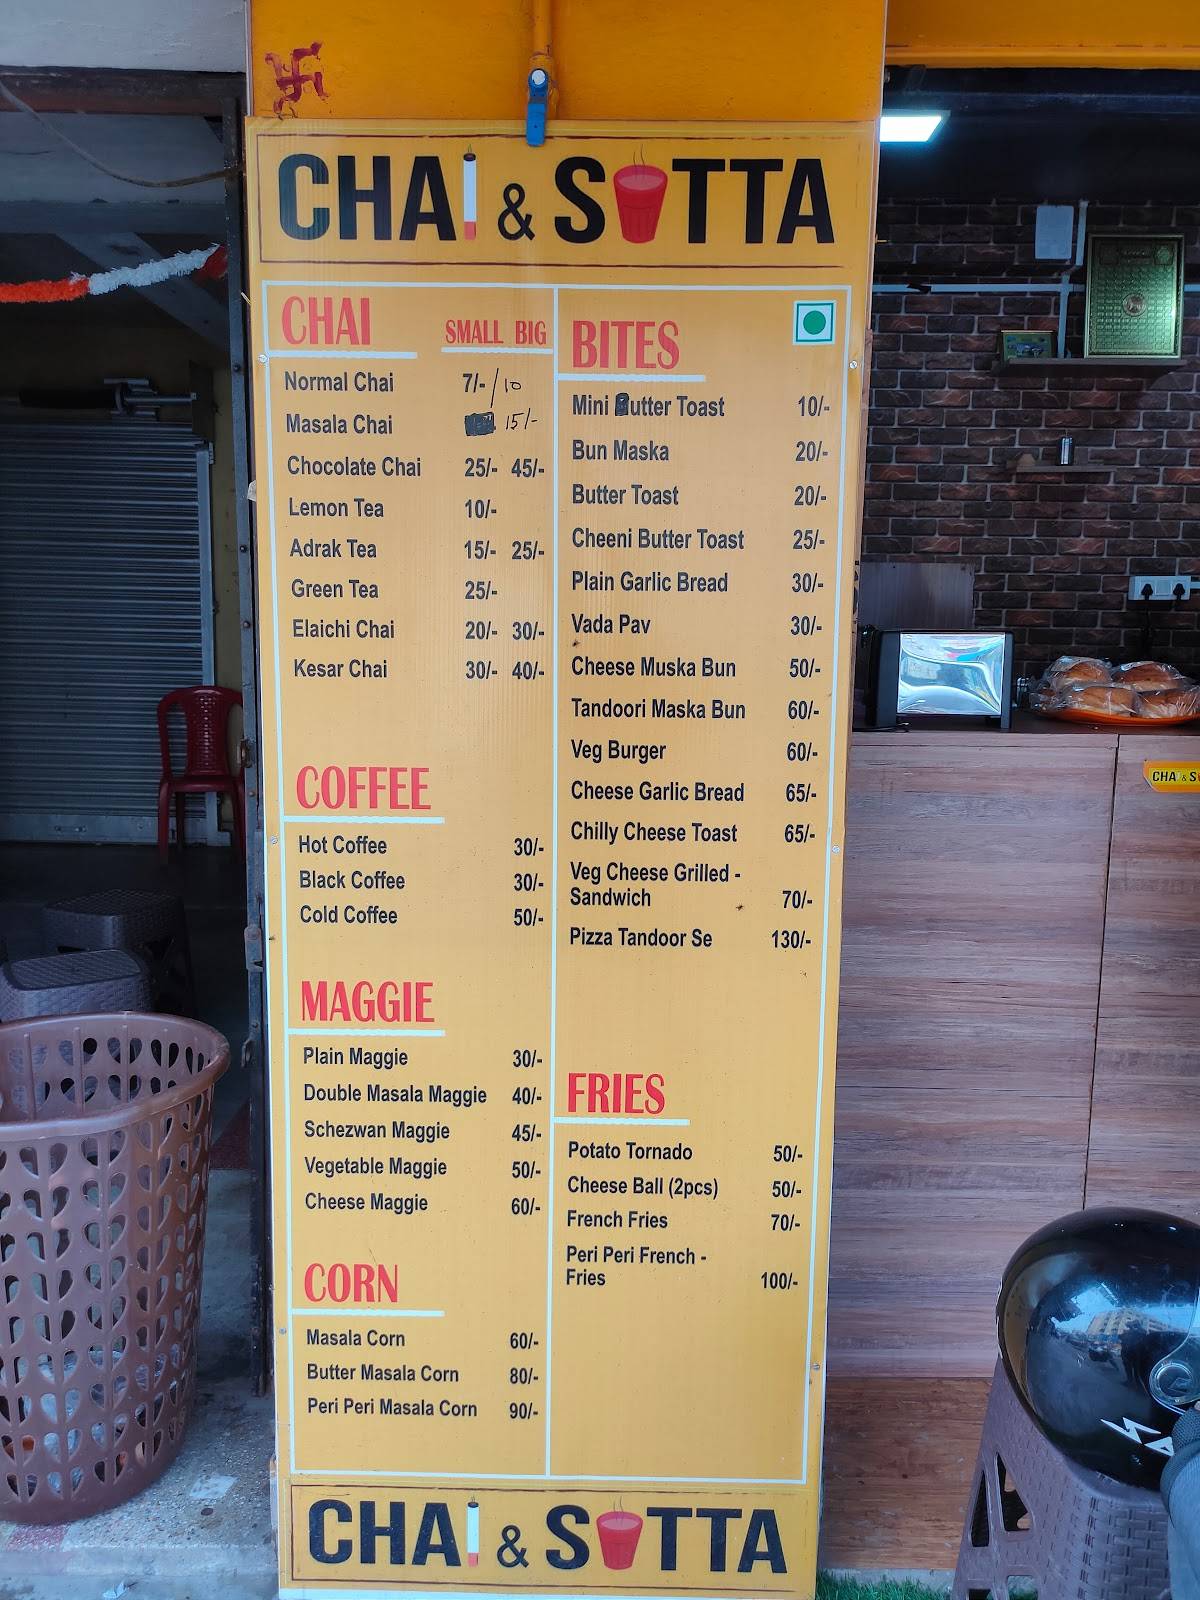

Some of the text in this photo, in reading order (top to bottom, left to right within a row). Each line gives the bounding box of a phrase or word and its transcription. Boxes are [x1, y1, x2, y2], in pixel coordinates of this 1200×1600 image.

[497, 182, 536, 241] &
[281, 296, 547, 346] CHAI SMALL BIG
[572, 319, 680, 370] BITES
[284, 371, 487, 394] Normal Chai 7/-
[572, 392, 830, 417] Mini utter Toast 10/-
[286, 413, 393, 435] Masala Chai
[505, 407, 538, 430] 15/-
[572, 439, 829, 462] Bun Maska 20/-
[287, 455, 545, 478] Chocolate Chai 25/- 45/-
[572, 483, 827, 507] Butter Toast 20/-
[289, 497, 497, 519] Lemon Tea 10/-
[289, 538, 545, 561] Adrak Tea 15/- 25/-
[572, 527, 825, 550] Cheeni Butter Toast 25/-
[291, 578, 498, 600] Green Tea 25/-
[572, 570, 824, 593] Plain Garlic Bread 30/-
[292, 618, 545, 641] Elaichi Chai 20/- 30/-
[570, 613, 823, 636] Vada Pav 30/-
[294, 658, 545, 681] Kesar Chai 30/- 40/-
[571, 655, 821, 679] Cheese Muska Bun 50/-
[571, 697, 820, 720] Tandoori Maska Bun 60/-
[570, 738, 819, 765] Veg Burger 60/-
[295, 764, 432, 811] COFFEE
[571, 779, 817, 803] Cheese Garlic Bread 65/-
[570, 820, 816, 846] Chilly Cheese Toast 65/-
[298, 834, 545, 857] Hot Coffee 30/-
[299, 869, 544, 892] Black Coffee 30/-
[569, 861, 601, 886] Veg
[606, 861, 669, 882] Cheese
[673, 862, 730, 883] Grilled
[569, 886, 813, 910] Sandwich 70/-
[300, 904, 544, 927] Cold Coffee 50/-
[570, 926, 812, 949] Pizza Tandoor Se 130/-
[300, 980, 436, 1024] MAGGIE
[303, 1046, 543, 1070] Plain Maggie 30/-
[304, 1083, 543, 1108] Double Masala Maggie 40/-
[566, 1071, 666, 1116] FRIES
[304, 1119, 542, 1144] Schezwan Maggie 45/-
[568, 1140, 803, 1163] Potato Tornado 50/-
[304, 1156, 542, 1180] Vegetable Maggie 50/-
[567, 1175, 802, 1201] Cheese Ball (2pcs) 50/-
[305, 1192, 541, 1216] Cheese Maggie 60/-
[567, 1209, 801, 1232] French Fries 70/-
[566, 1244, 598, 1263] Peri
[603, 1245, 635, 1264] Peri
[638, 1246, 696, 1265] French
[303, 1263, 399, 1303] CORN
[566, 1268, 799, 1290] Fries 100/-
[306, 1328, 539, 1350] Masala Corn 60/-
[307, 1363, 539, 1385] Butter Masala Corn 80/-
[307, 1397, 539, 1420] Peri Peri Masala Corn 90/-
[496, 1524, 530, 1568] &
